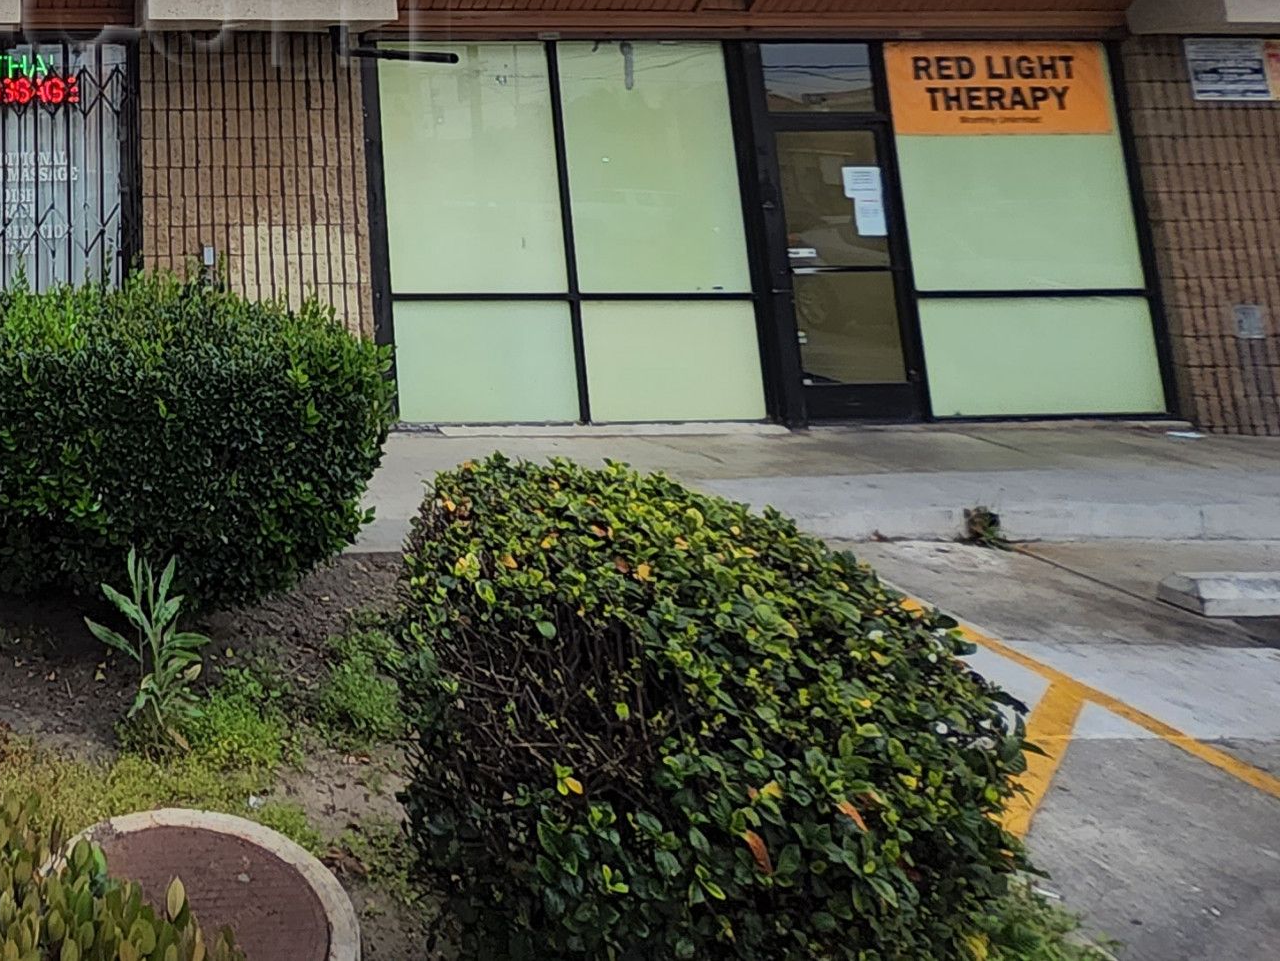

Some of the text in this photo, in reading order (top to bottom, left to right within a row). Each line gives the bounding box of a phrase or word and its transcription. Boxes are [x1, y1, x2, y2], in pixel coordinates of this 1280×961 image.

[912, 55, 1074, 80] RED LIGHT
[925, 86, 1070, 111] THERAPY
